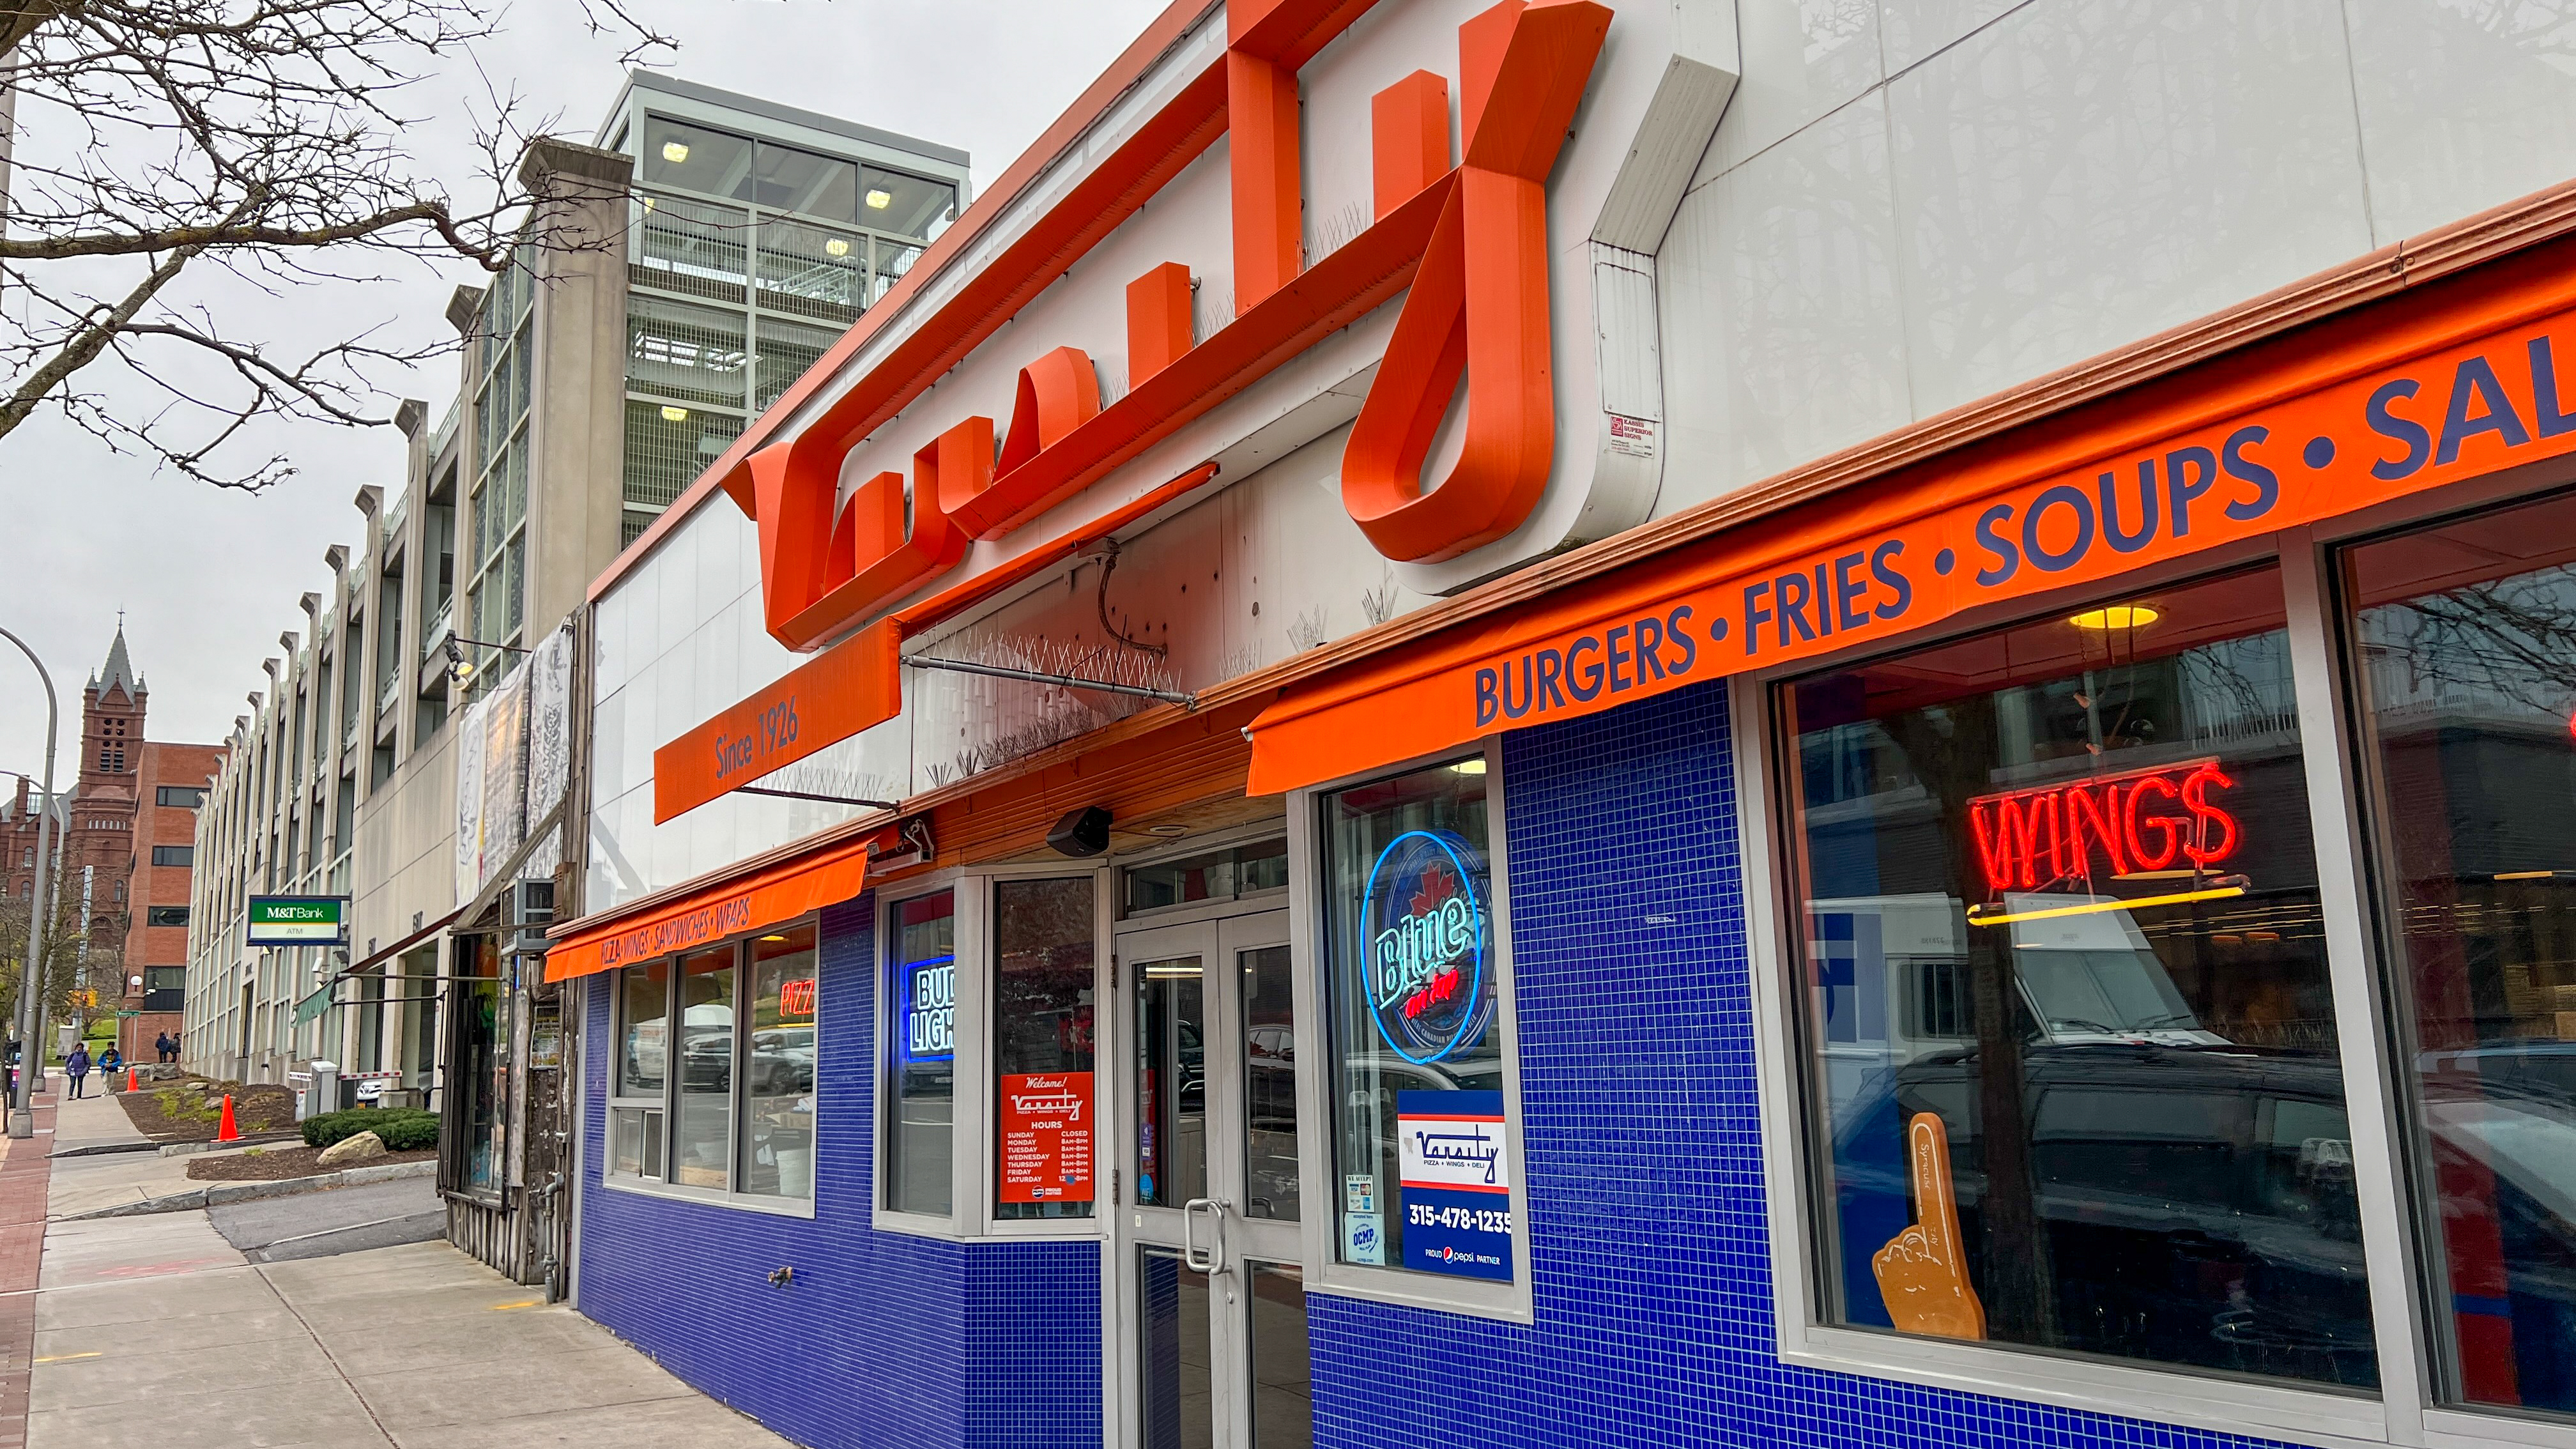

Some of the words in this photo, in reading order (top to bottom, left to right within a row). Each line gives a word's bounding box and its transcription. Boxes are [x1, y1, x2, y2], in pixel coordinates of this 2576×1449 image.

[1623, 425, 1653, 436] SUPERIOR
[1624, 432, 1641, 440] SIGNS
[1475, 605, 1696, 728] BURGERS
[1744, 539, 1912, 657] FRIES
[1975, 425, 2280, 587] SOUPS
[715, 733, 753, 779] Since
[758, 694, 799, 756] 1926
[1970, 764, 2237, 890] WINGS
[267, 907, 296, 919] M&T
[297, 907, 323, 919] Bank
[624, 929, 648, 958] WINGS
[654, 910, 710, 951] SANDWICHES
[1375, 897, 1471, 1010] Blue
[780, 979, 815, 1016] PIZZ
[910, 1008, 954, 1052] LIGH
[1421, 1029, 1446, 1044] CANADIAN
[1025, 1076, 1067, 1089] Welcome!
[1011, 1089, 1083, 1121] Varsity
[1031, 1121, 1062, 1129] HOURS
[1416, 1124, 1499, 1184] Varsity
[1409, 1204, 1512, 1234] 315-478-1235
[1353, 1228, 1374, 1246] OCMP
[1425, 1249, 1442, 1259] PROUD
[1453, 1252, 1475, 1263] pepsi
[1476, 1255, 1500, 1266] PARTNER
